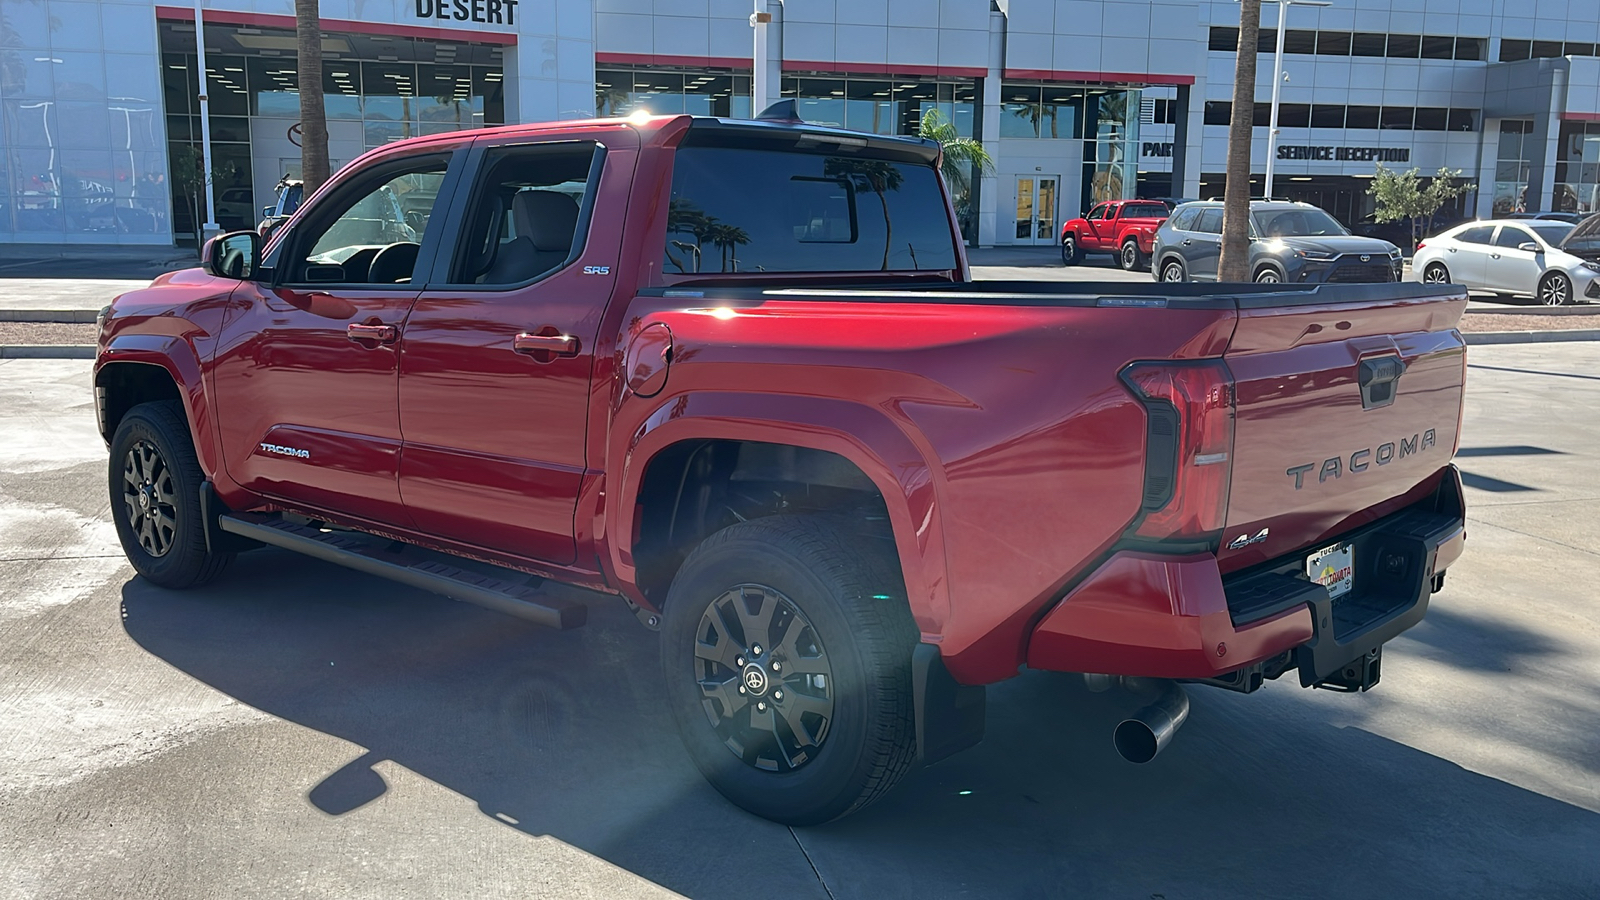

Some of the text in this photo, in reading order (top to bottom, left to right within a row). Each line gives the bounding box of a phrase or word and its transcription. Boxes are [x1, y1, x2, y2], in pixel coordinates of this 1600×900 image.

[416, 0, 518, 25] DESERT
[1277, 145, 1410, 162] SERVICE RECEPTION
[583, 265, 610, 275] SR5
[260, 442, 310, 459] TACOMA
[1286, 428, 1436, 490] TACOMA
